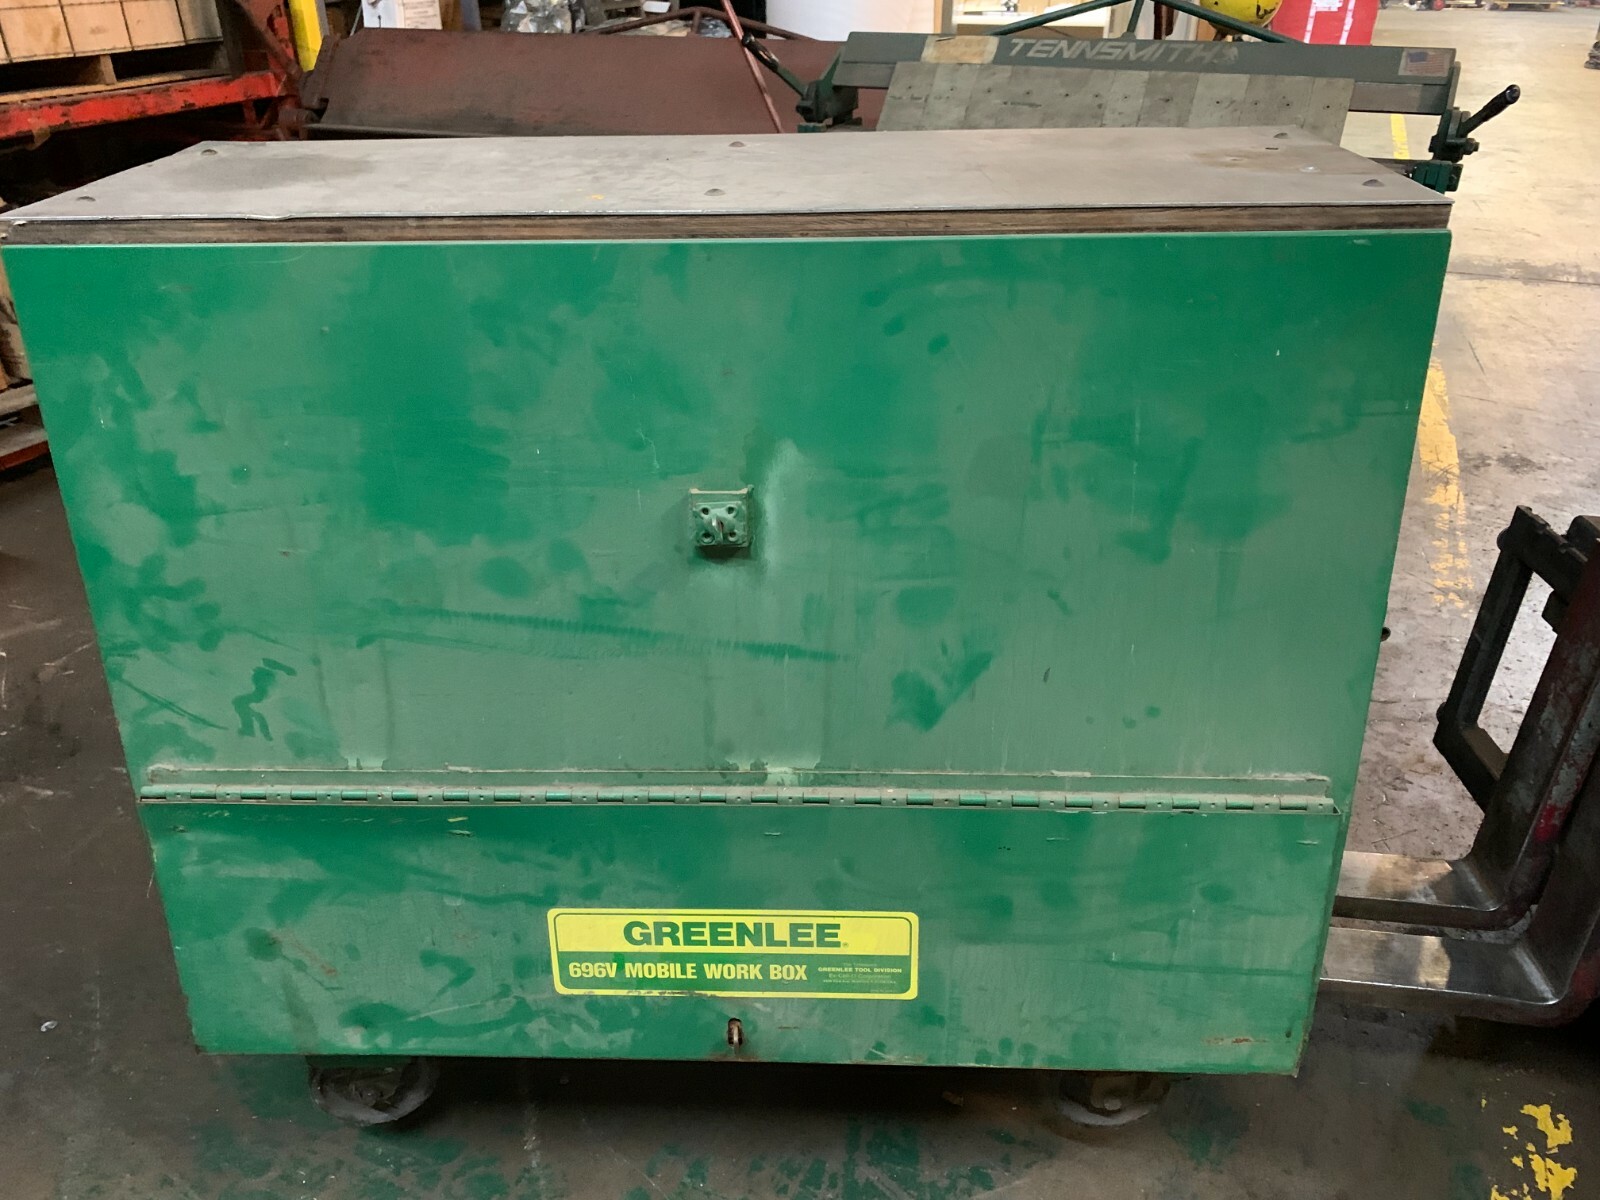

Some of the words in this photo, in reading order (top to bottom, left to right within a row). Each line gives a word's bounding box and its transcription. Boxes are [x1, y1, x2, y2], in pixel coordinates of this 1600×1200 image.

[1009, 38, 1218, 63] TENNSMITH
[623, 920, 842, 948] GREENLEE
[568, 962, 618, 978] 696V
[624, 962, 698, 979] MOBILE
[703, 963, 763, 981] WORK
[769, 964, 808, 981] BOX
